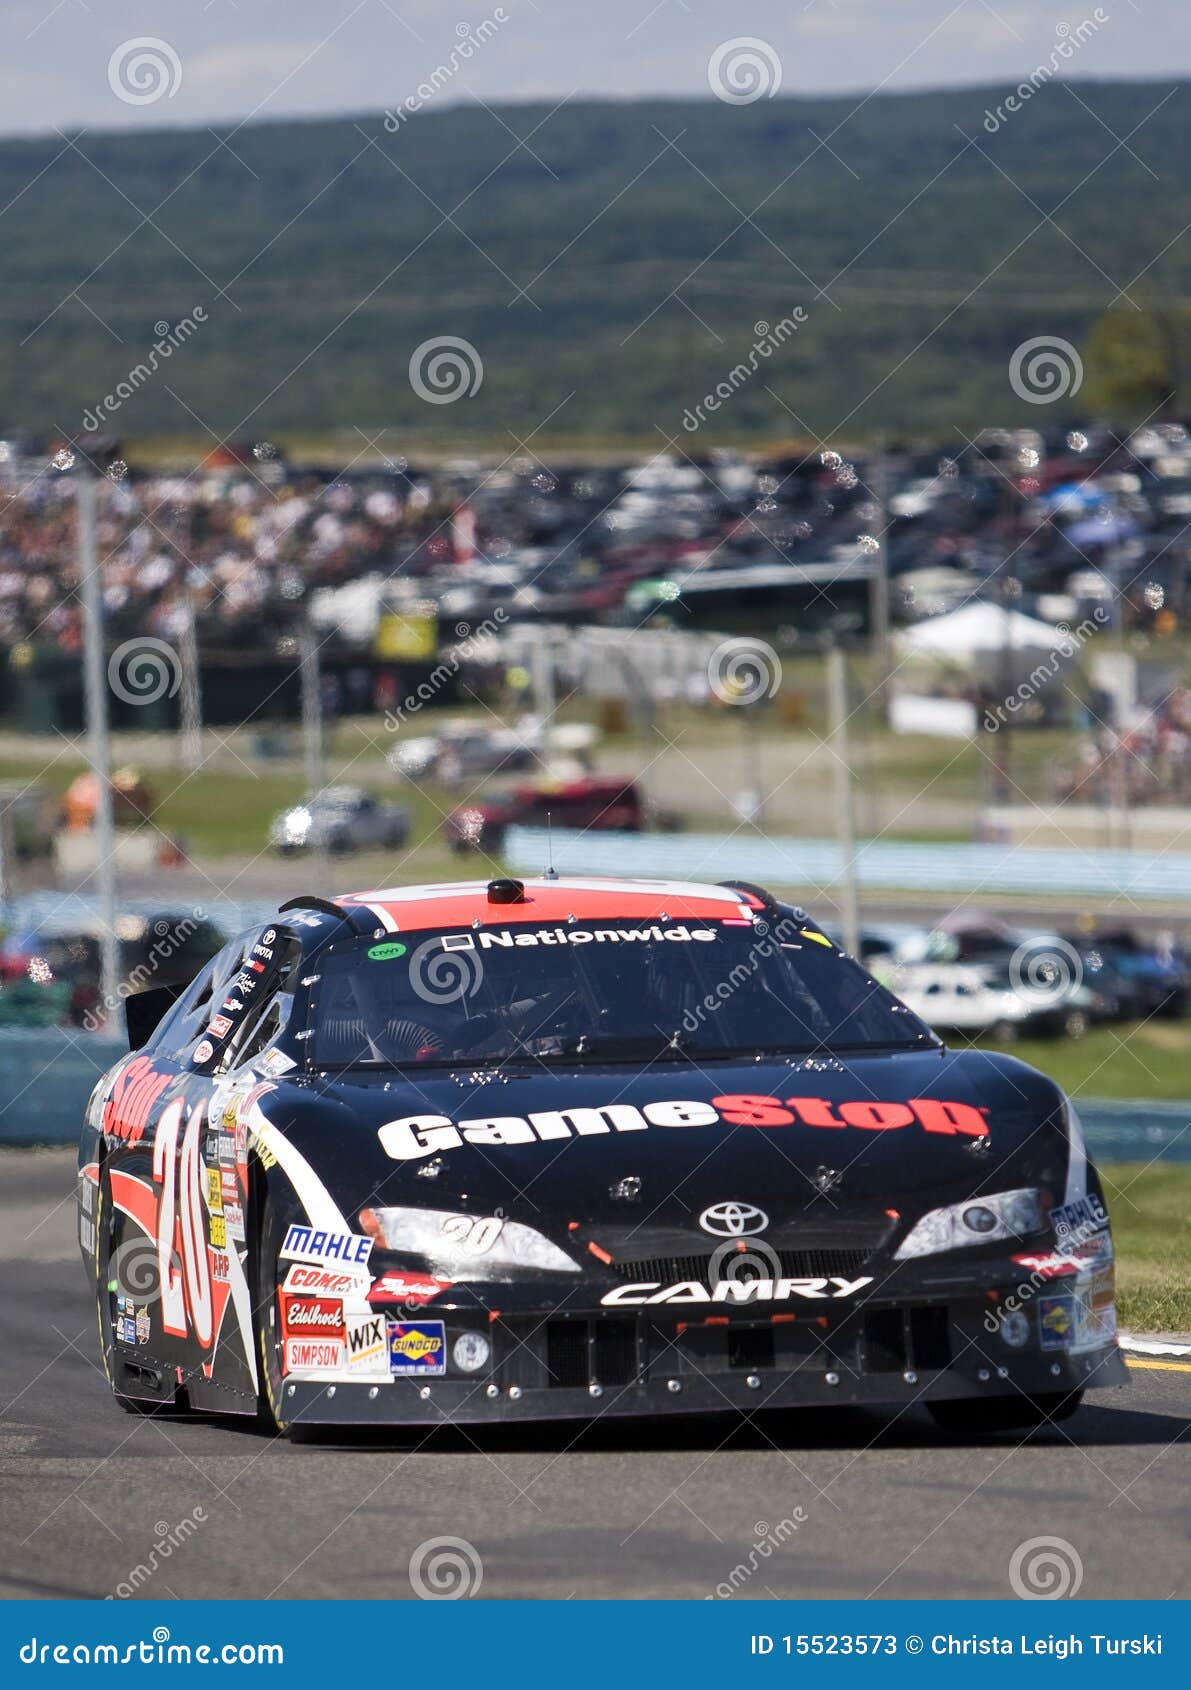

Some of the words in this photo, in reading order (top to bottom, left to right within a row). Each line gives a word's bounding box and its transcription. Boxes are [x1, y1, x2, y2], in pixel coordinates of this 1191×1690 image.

[480, 926, 717, 949] Nationwide
[377, 1095, 990, 1160] GameStop
[153, 1096, 214, 1347] 20
[441, 1215, 504, 1256] 20
[285, 1227, 372, 1263] MAHLE
[290, 1269, 352, 1288] COMP
[600, 1276, 874, 1306] CAMRY
[287, 1303, 343, 1327] Edelbrock
[348, 1318, 383, 1352] WIX
[394, 1339, 440, 1351] SUNOCO
[292, 1345, 339, 1366] SIMPSON
